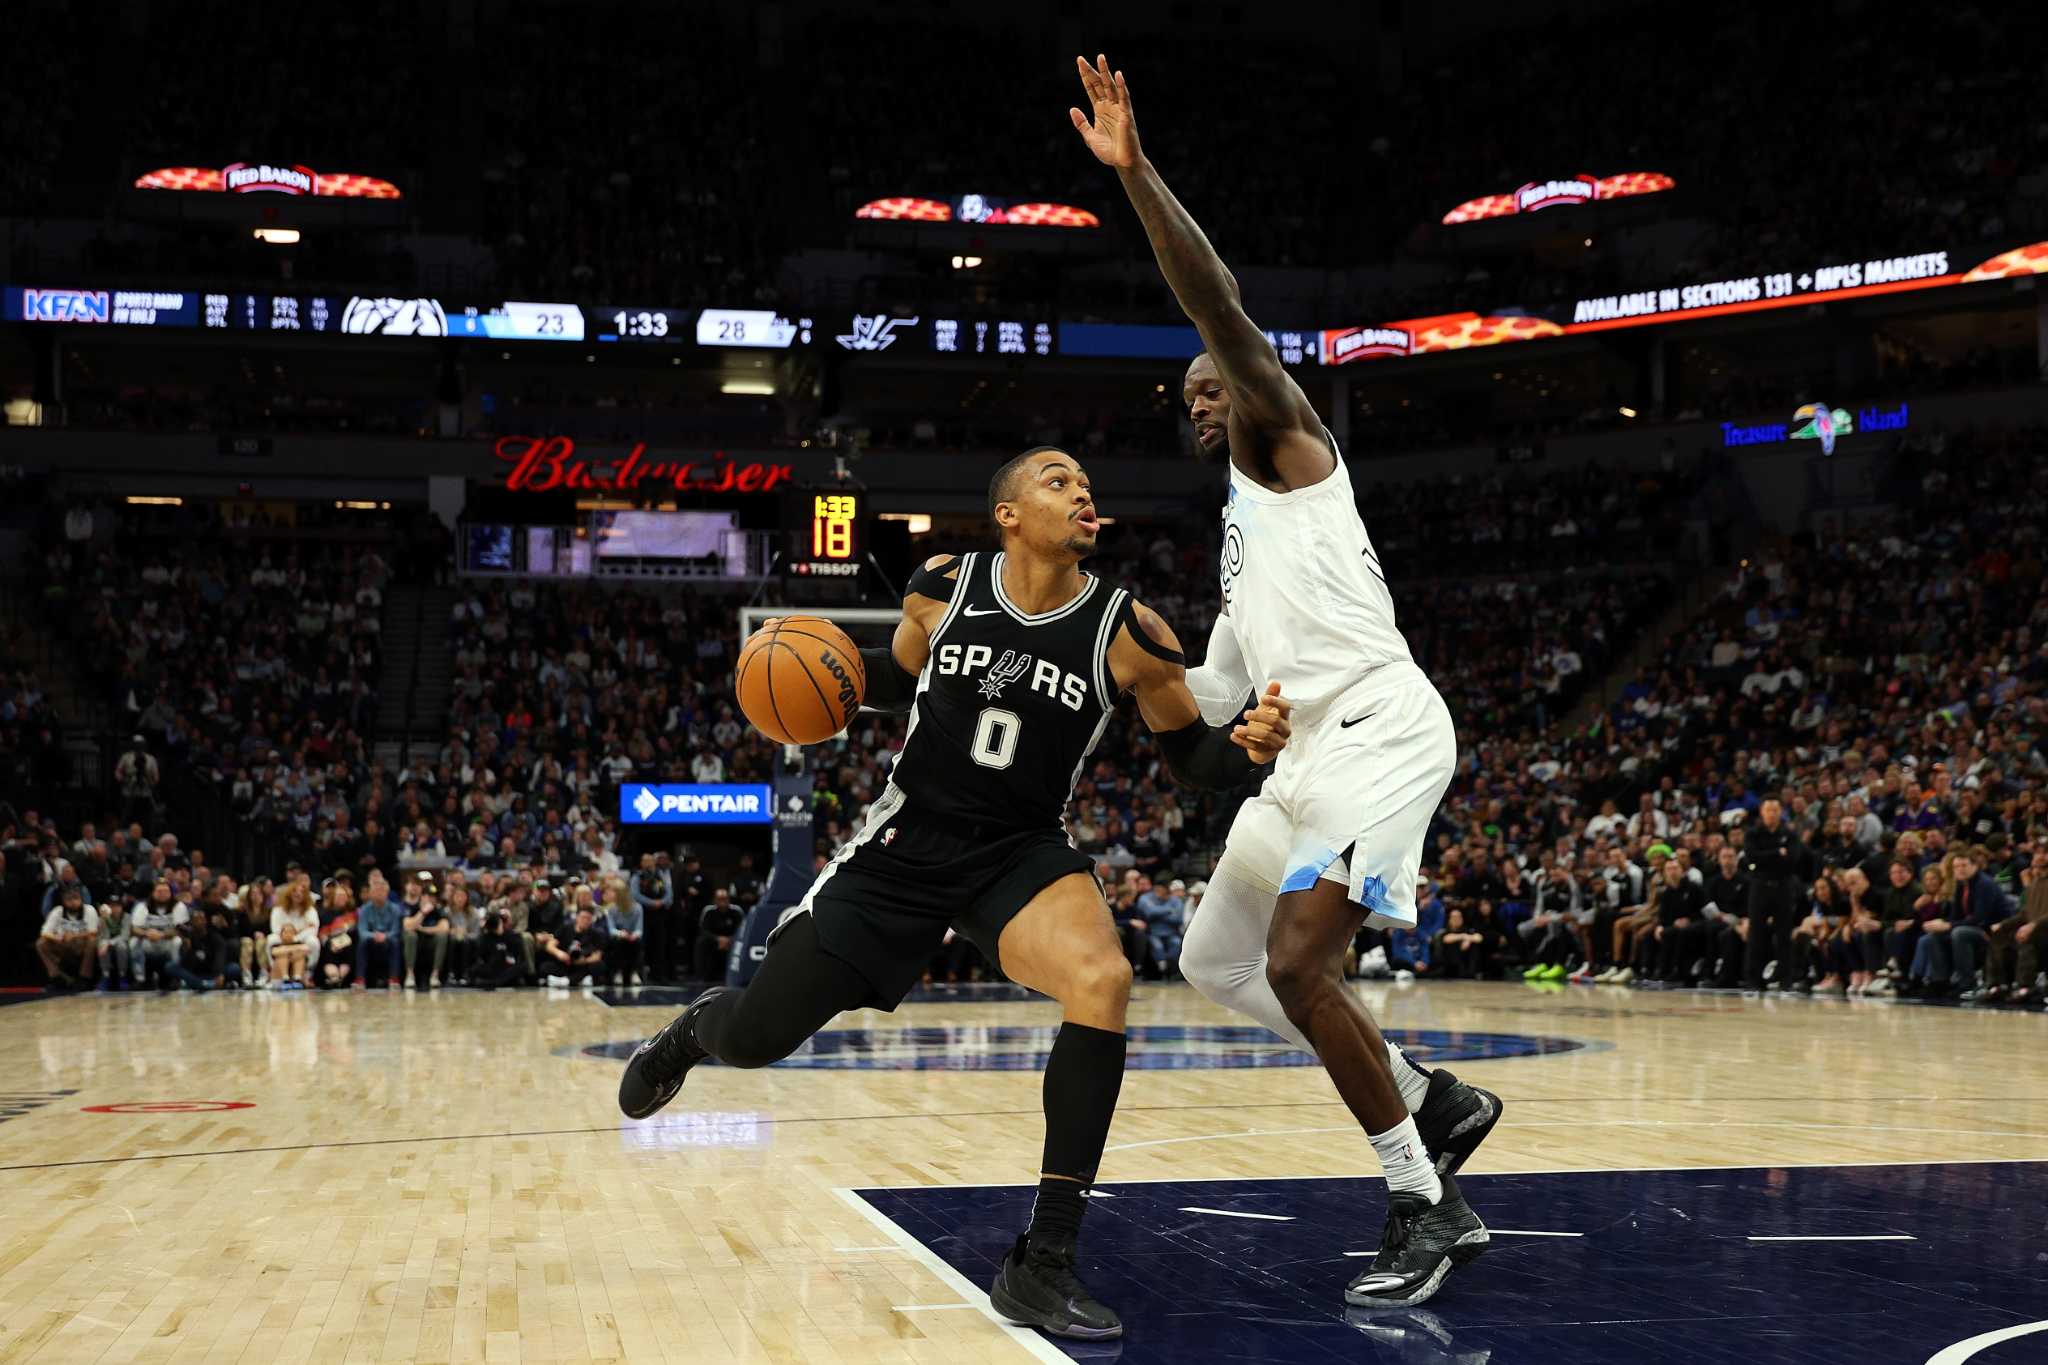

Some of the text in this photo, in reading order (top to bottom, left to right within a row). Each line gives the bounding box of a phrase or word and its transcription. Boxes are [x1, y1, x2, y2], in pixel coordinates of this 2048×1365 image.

[229, 164, 310, 191] RED BARON
[1573, 290, 1658, 323] AVAILABLE
[1658, 288, 1679, 312] IN
[1681, 277, 1761, 309] SECTIONS
[1763, 272, 1792, 298] 131
[1814, 263, 1863, 292] MPLS
[1864, 251, 1949, 285] MARKETS
[24, 288, 109, 323] KFAN
[536, 313, 565, 335] 23
[613, 309, 669, 337] 1:33
[718, 319, 745, 341] 28
[814, 495, 856, 519] 1:33
[814, 518, 851, 558] 18
[809, 562, 860, 576] TISSOT
[938, 644, 1087, 712] SPURS
[970, 706, 1022, 770] 0
[662, 793, 760, 814] PENTAIR
